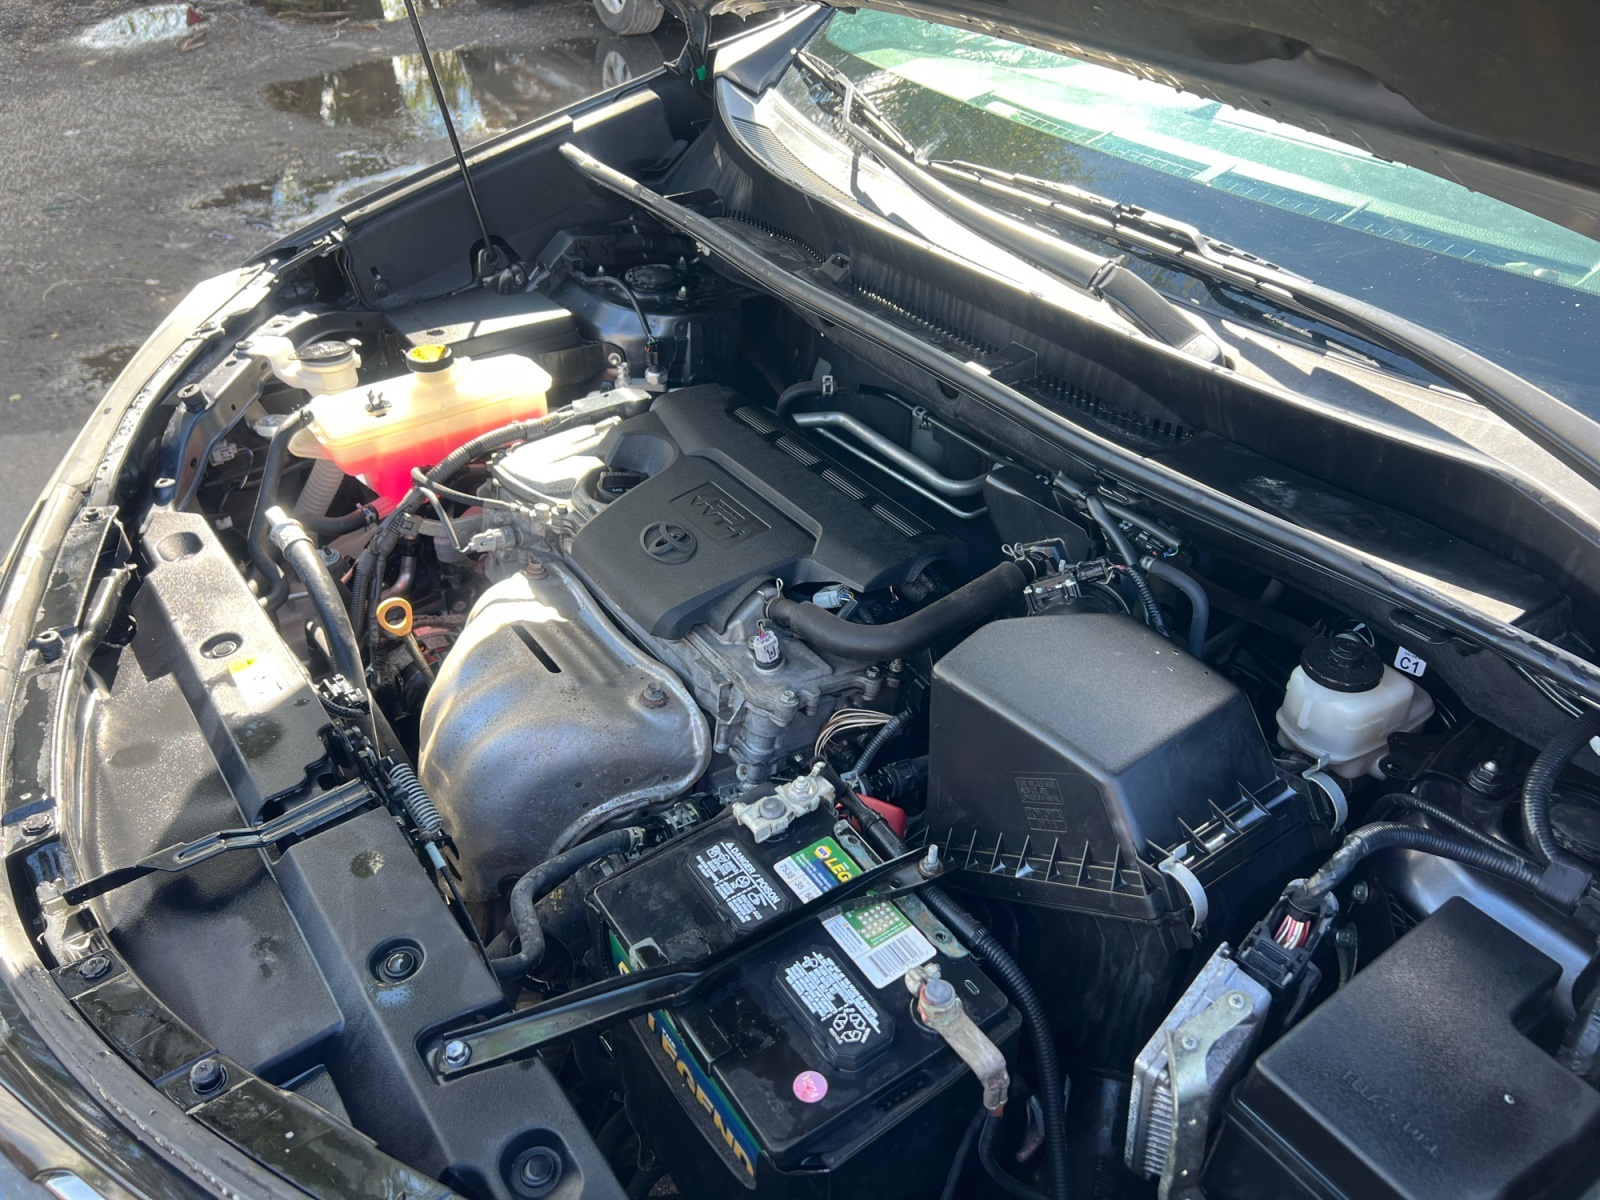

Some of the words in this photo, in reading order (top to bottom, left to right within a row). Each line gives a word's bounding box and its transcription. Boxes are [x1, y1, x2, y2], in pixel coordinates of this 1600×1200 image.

[1400, 656, 1419, 674] C1
[730, 846, 756, 874] DANGER
[755, 876, 780, 903] POISON
[778, 863, 795, 879] 7535
[793, 880, 805, 890] 35
